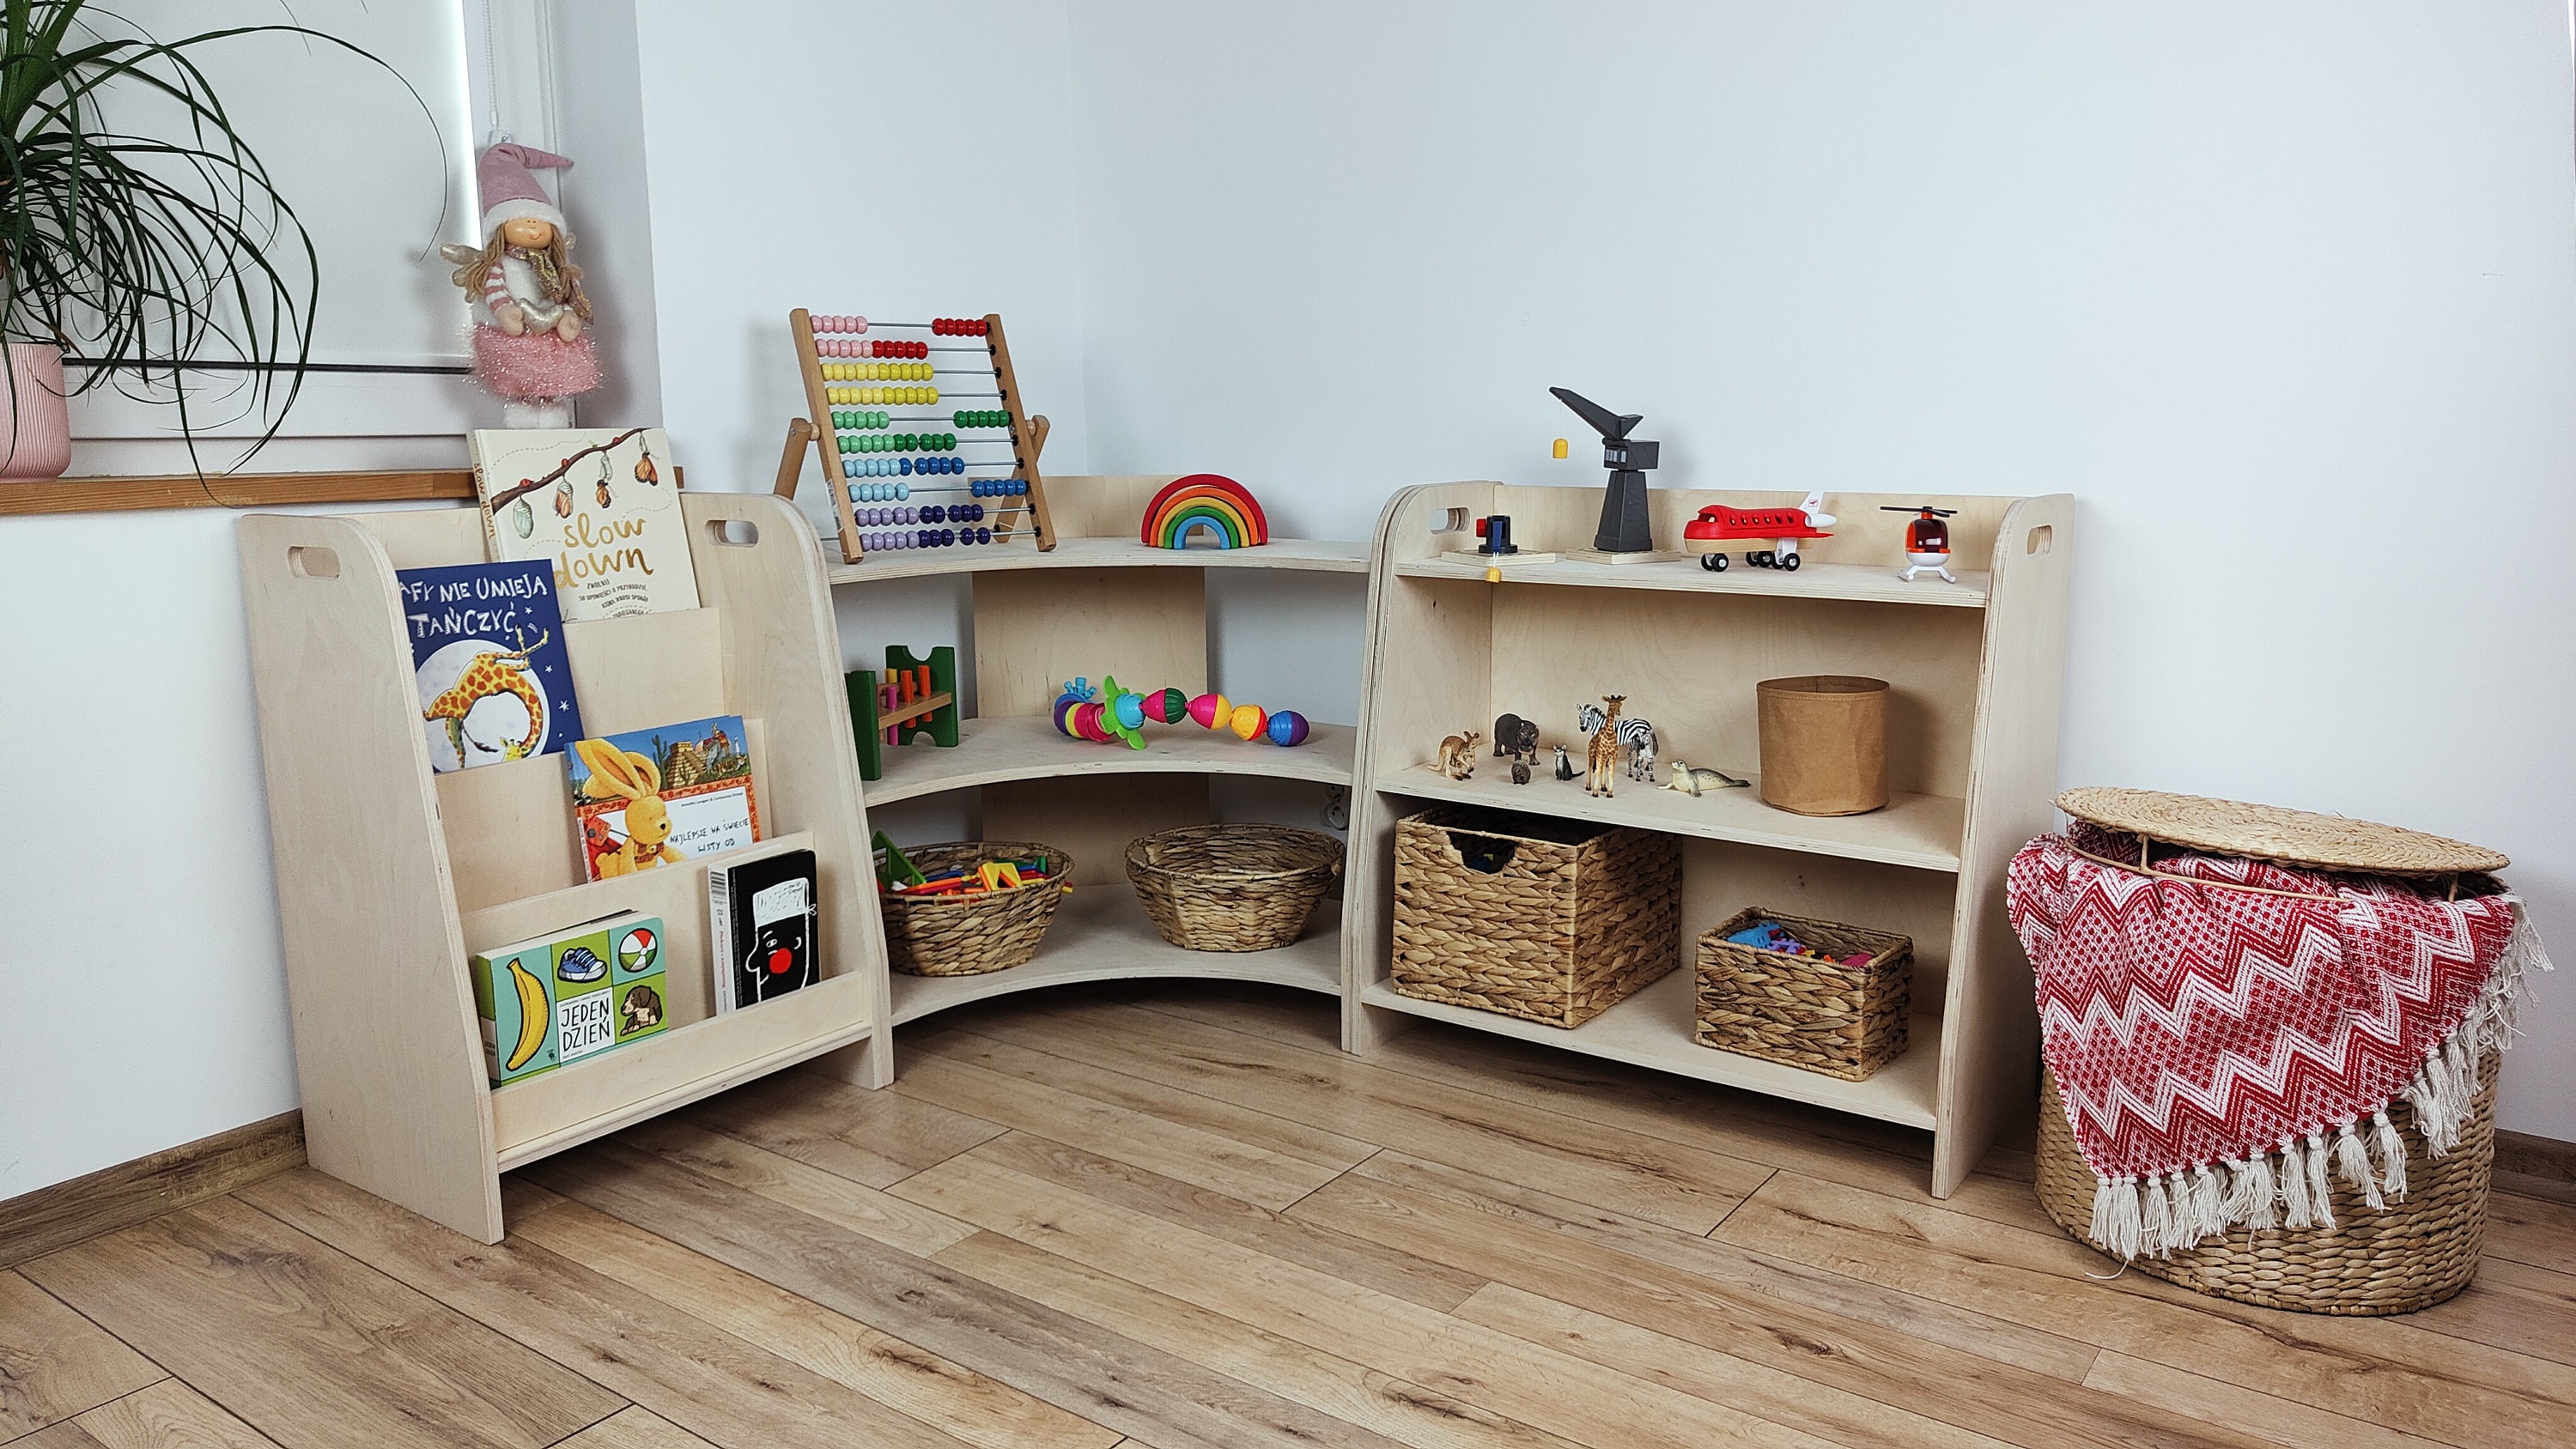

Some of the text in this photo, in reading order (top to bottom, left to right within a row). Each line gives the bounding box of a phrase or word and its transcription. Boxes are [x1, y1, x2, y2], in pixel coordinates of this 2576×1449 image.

[473, 463, 495, 540] slow down
[563, 512, 646, 548] slow
[553, 548, 653, 590] down
[440, 582, 471, 603] NIE
[407, 601, 517, 638] TAŃCZYĆ
[670, 818, 750, 845] NAJLEPSZE NA ŚWIECIE
[698, 838, 735, 852] LISTY OD
[561, 997, 610, 1028] JEDEN
[562, 1016, 611, 1052] DZIEŃ
